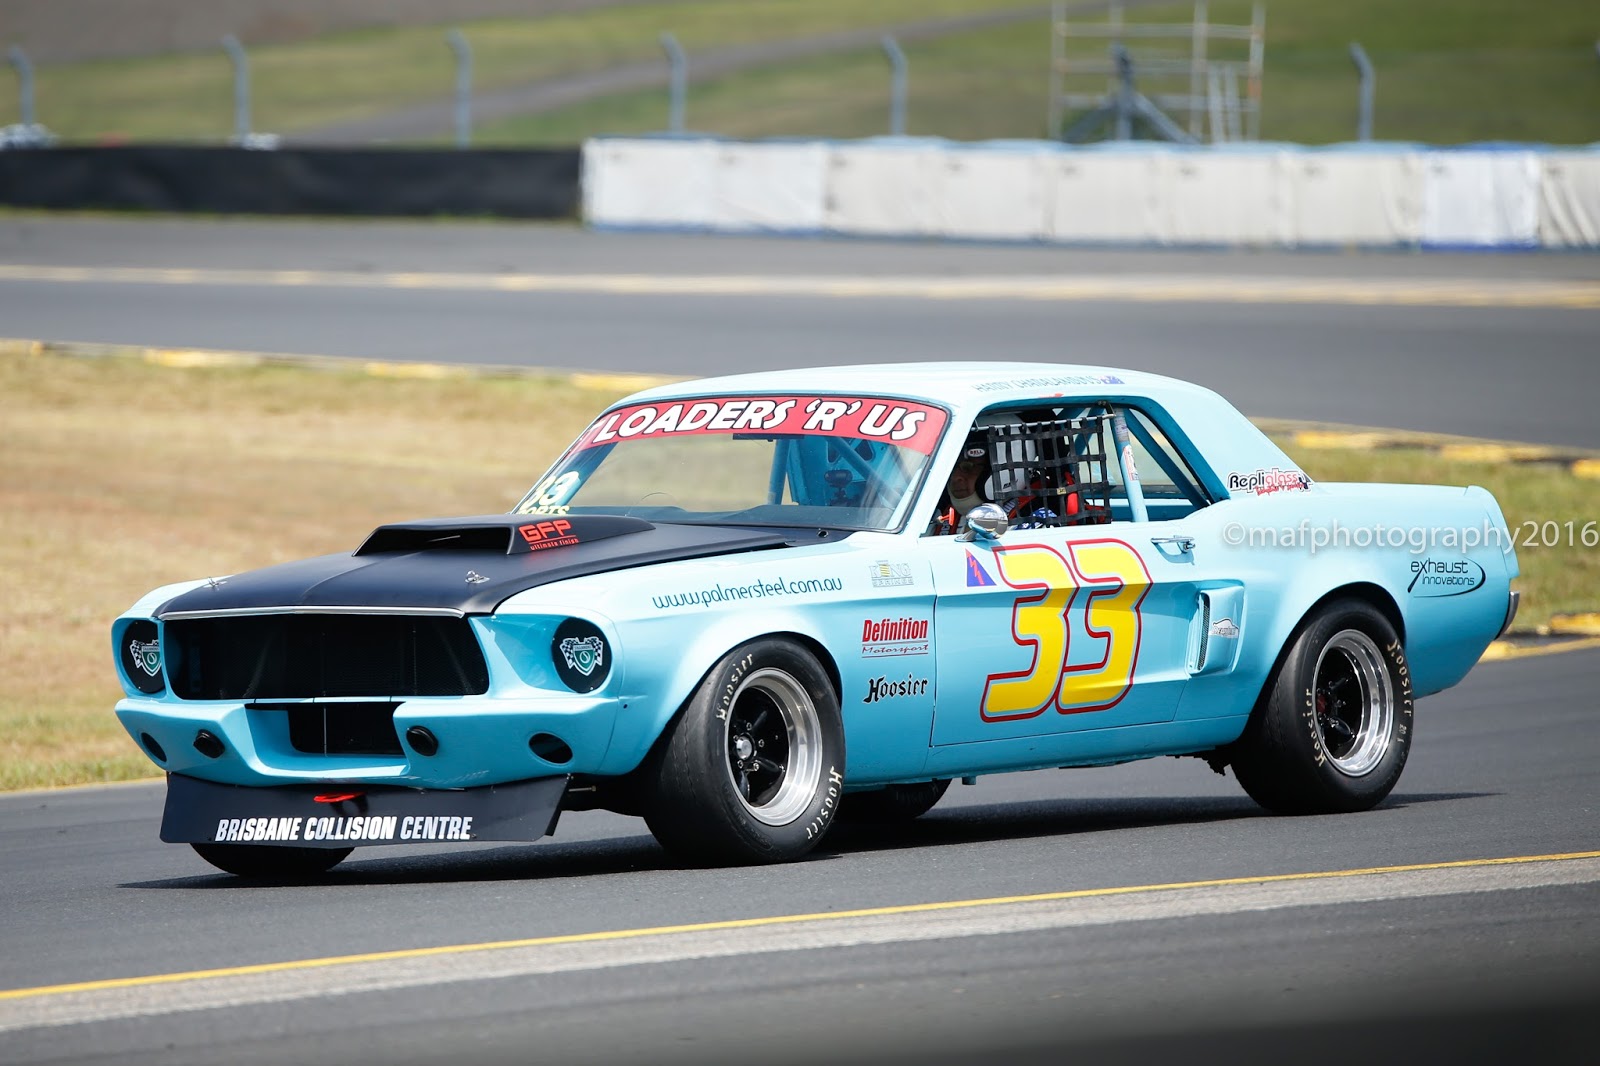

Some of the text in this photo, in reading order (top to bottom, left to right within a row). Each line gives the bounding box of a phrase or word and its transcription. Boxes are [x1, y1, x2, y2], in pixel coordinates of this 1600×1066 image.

[593, 398, 798, 444] LOADERS
[858, 401, 926, 442] US
[518, 519, 572, 542] GFP
[1408, 557, 1469, 584] exhaust
[1422, 574, 1475, 586] innovations
[652, 577, 843, 608] www.palmersteel.com.au
[862, 617, 929, 642] Definition
[980, 538, 1154, 723] 33
[862, 644, 929, 654] Motorsport
[863, 672, 929, 704] Hoosier
[215, 816, 473, 842] BRISBANE COLLISION CENTRE
